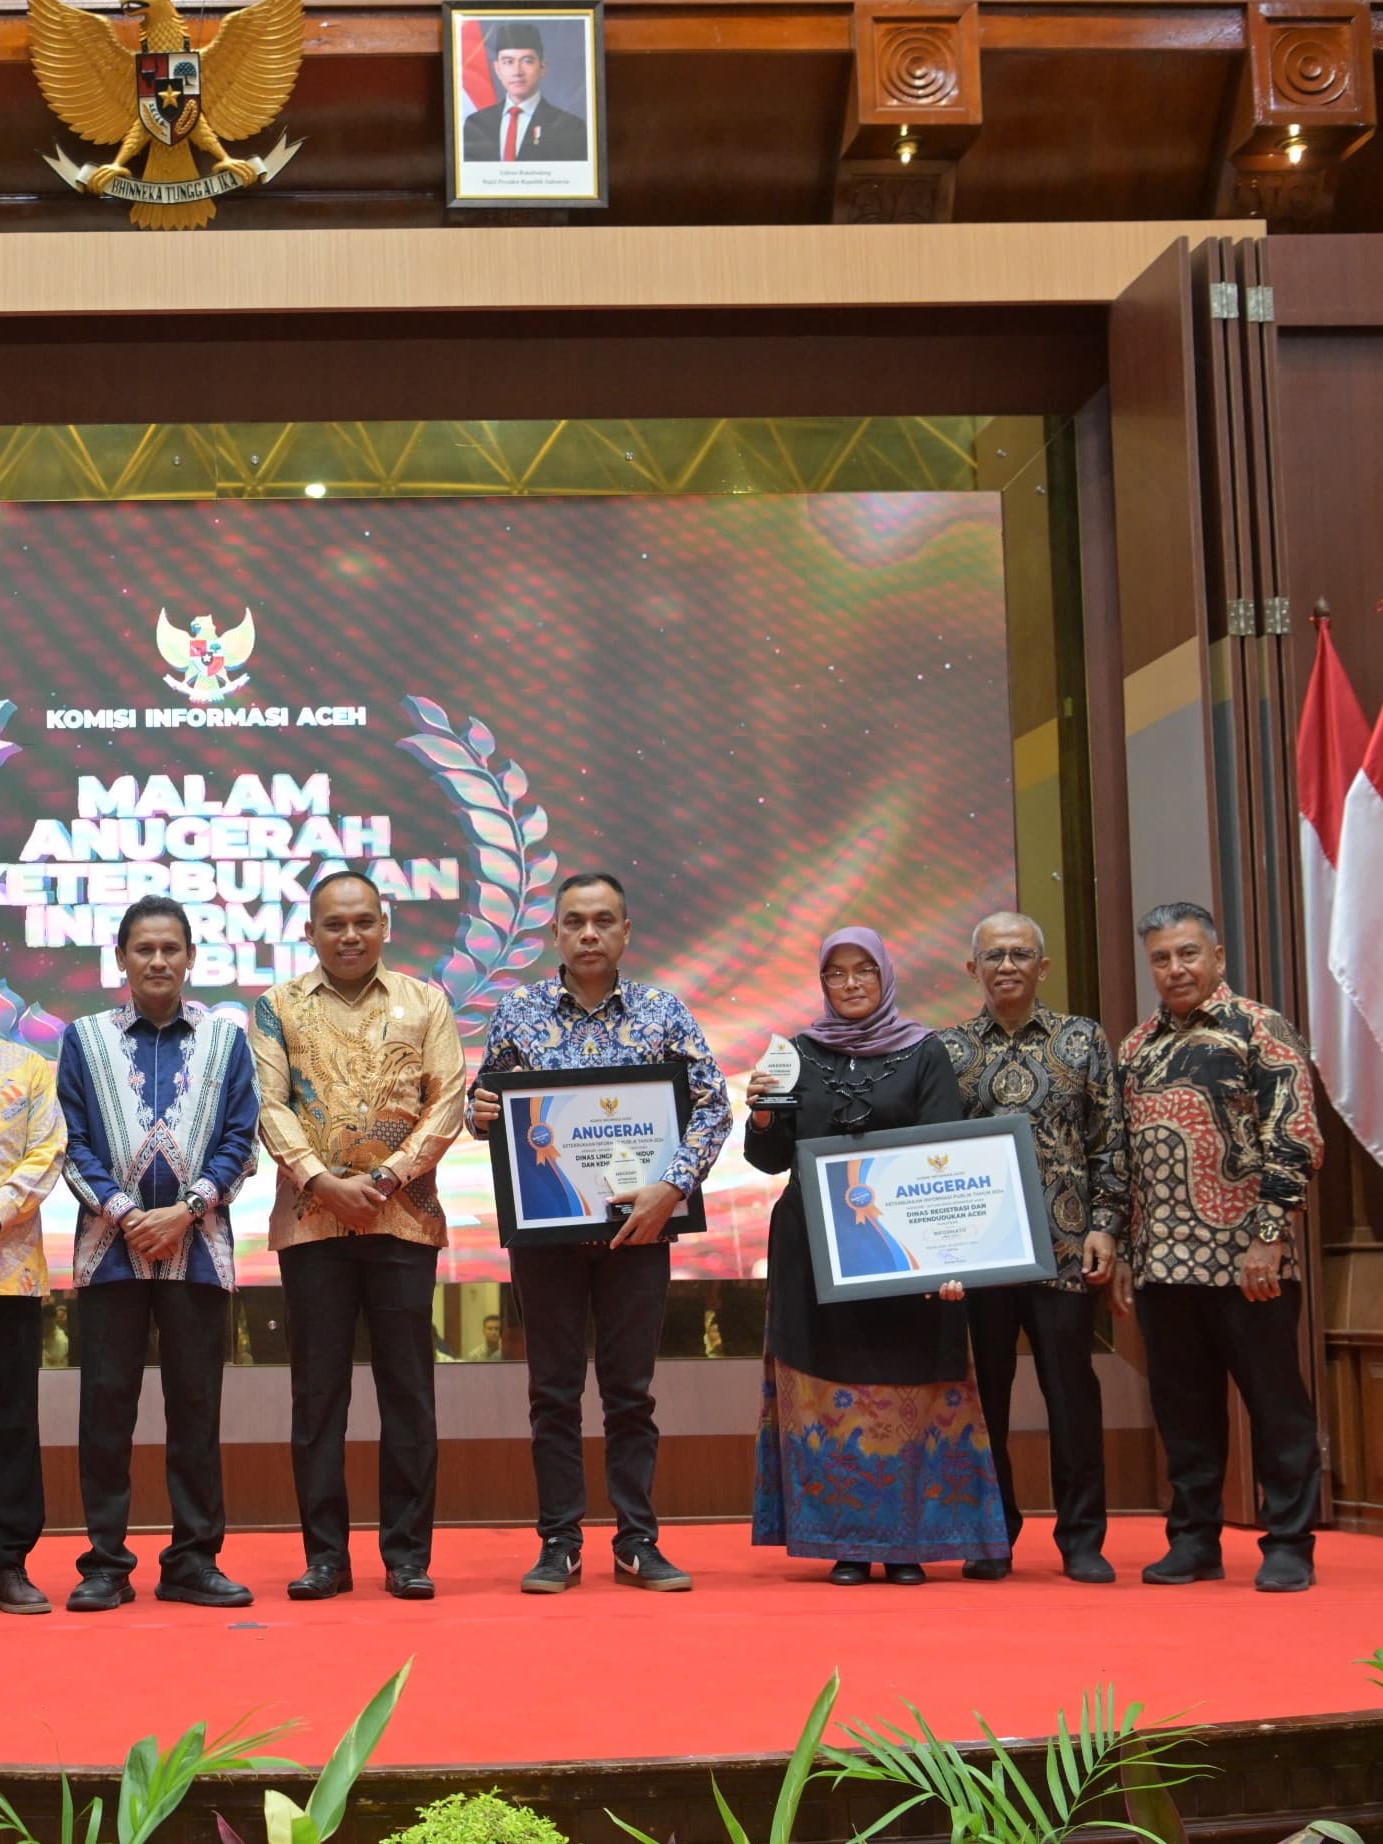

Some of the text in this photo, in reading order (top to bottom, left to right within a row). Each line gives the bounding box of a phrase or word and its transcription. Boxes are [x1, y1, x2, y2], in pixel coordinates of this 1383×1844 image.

[111, 171, 239, 201] BHINNEKA TUNGGAL IKA
[46, 706, 367, 729] KOMISI INFORMASI ACEH
[77, 773, 330, 818] MALAM
[19, 816, 391, 862] ANUGERAH
[25, 901, 392, 948] INFRMA
[100, 944, 320, 989] PBLI
[572, 1122, 654, 1140] ANUGERAH
[896, 1175, 992, 1198] ANUGERAH
[906, 1210, 928, 1218] DINAS
[930, 1205, 970, 1215] REGISTRASI
[909, 1213, 966, 1224] KEPENDUDUKAN
[968, 1210, 987, 1218] ACEH
